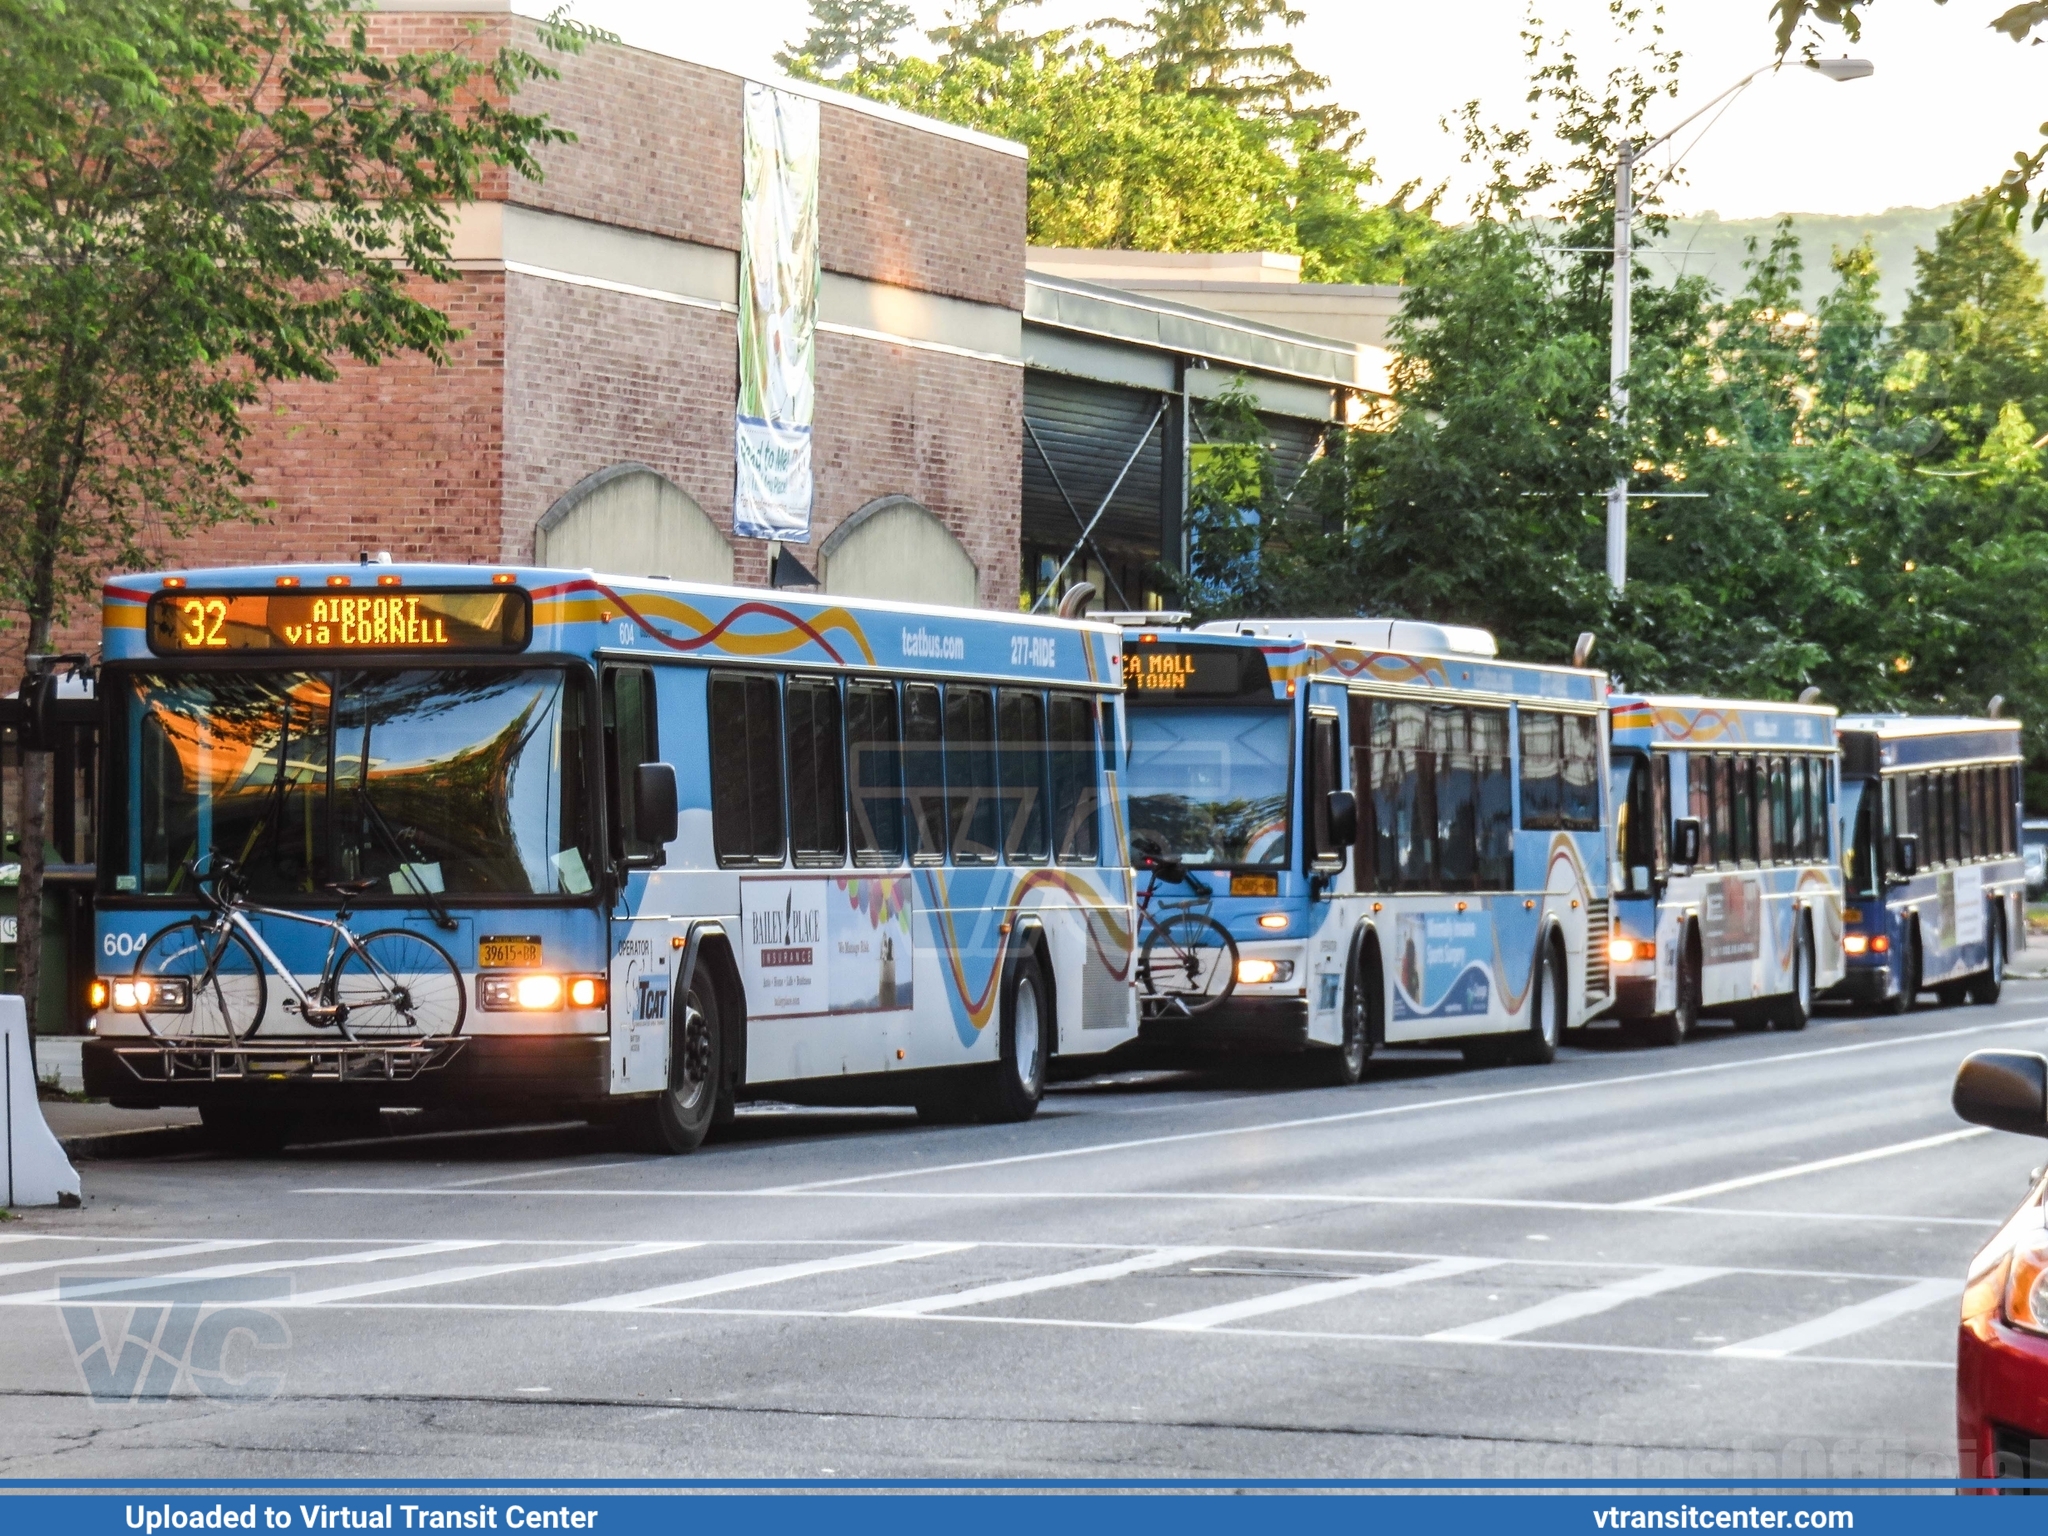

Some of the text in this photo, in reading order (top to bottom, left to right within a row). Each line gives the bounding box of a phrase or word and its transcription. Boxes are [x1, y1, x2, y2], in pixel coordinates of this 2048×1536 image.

[184, 600, 227, 646] 32
[313, 598, 420, 624] AIRPORT
[285, 619, 449, 645] via CORNELL
[619, 622, 635, 645] 604
[902, 626, 965, 660] tcatbus.com
[1011, 635, 1056, 668] 277-RIDE
[1149, 654, 1195, 673] MALL
[752, 909, 820, 945] BAILEY PLACE
[104, 933, 148, 957] 604
[618, 940, 649, 956] OPERATOR
[763, 950, 812, 966] INSURANCE
[639, 980, 667, 1020] TCAT
